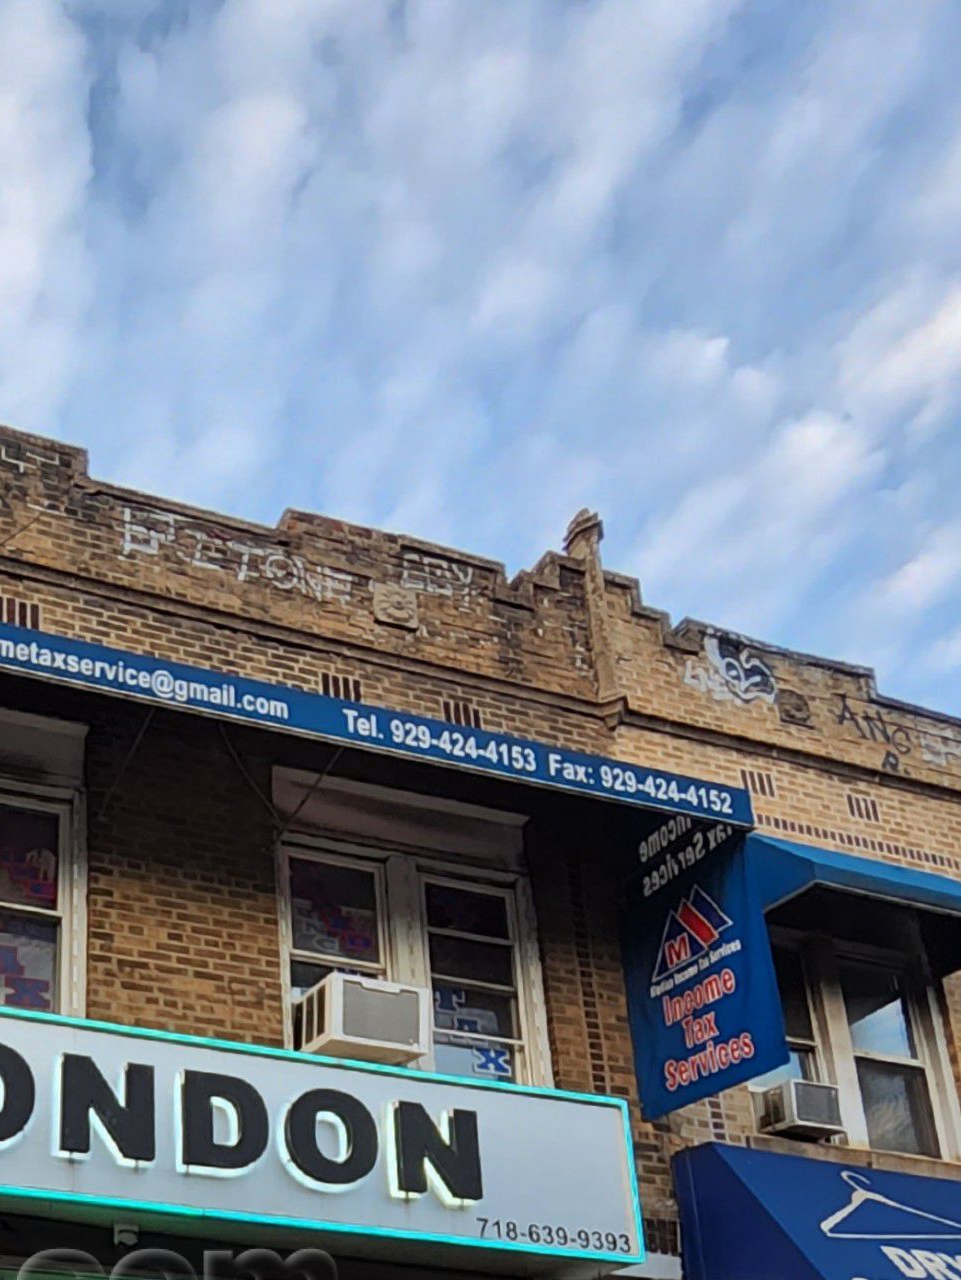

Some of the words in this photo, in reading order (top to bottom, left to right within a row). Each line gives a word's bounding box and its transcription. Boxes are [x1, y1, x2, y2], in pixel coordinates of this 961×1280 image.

[343, 707, 385, 743] Tel.
[390, 719, 537, 772] 929-424-4153
[547, 753, 595, 786] Fax:
[599, 765, 733, 815] 929-424-4152
[664, 931, 692, 969] M
[662, 967, 737, 1027] Income
[680, 1009, 720, 1050] Tax
[663, 1031, 756, 1092] Services
[475, 1217, 633, 1254] 718-639-9393
